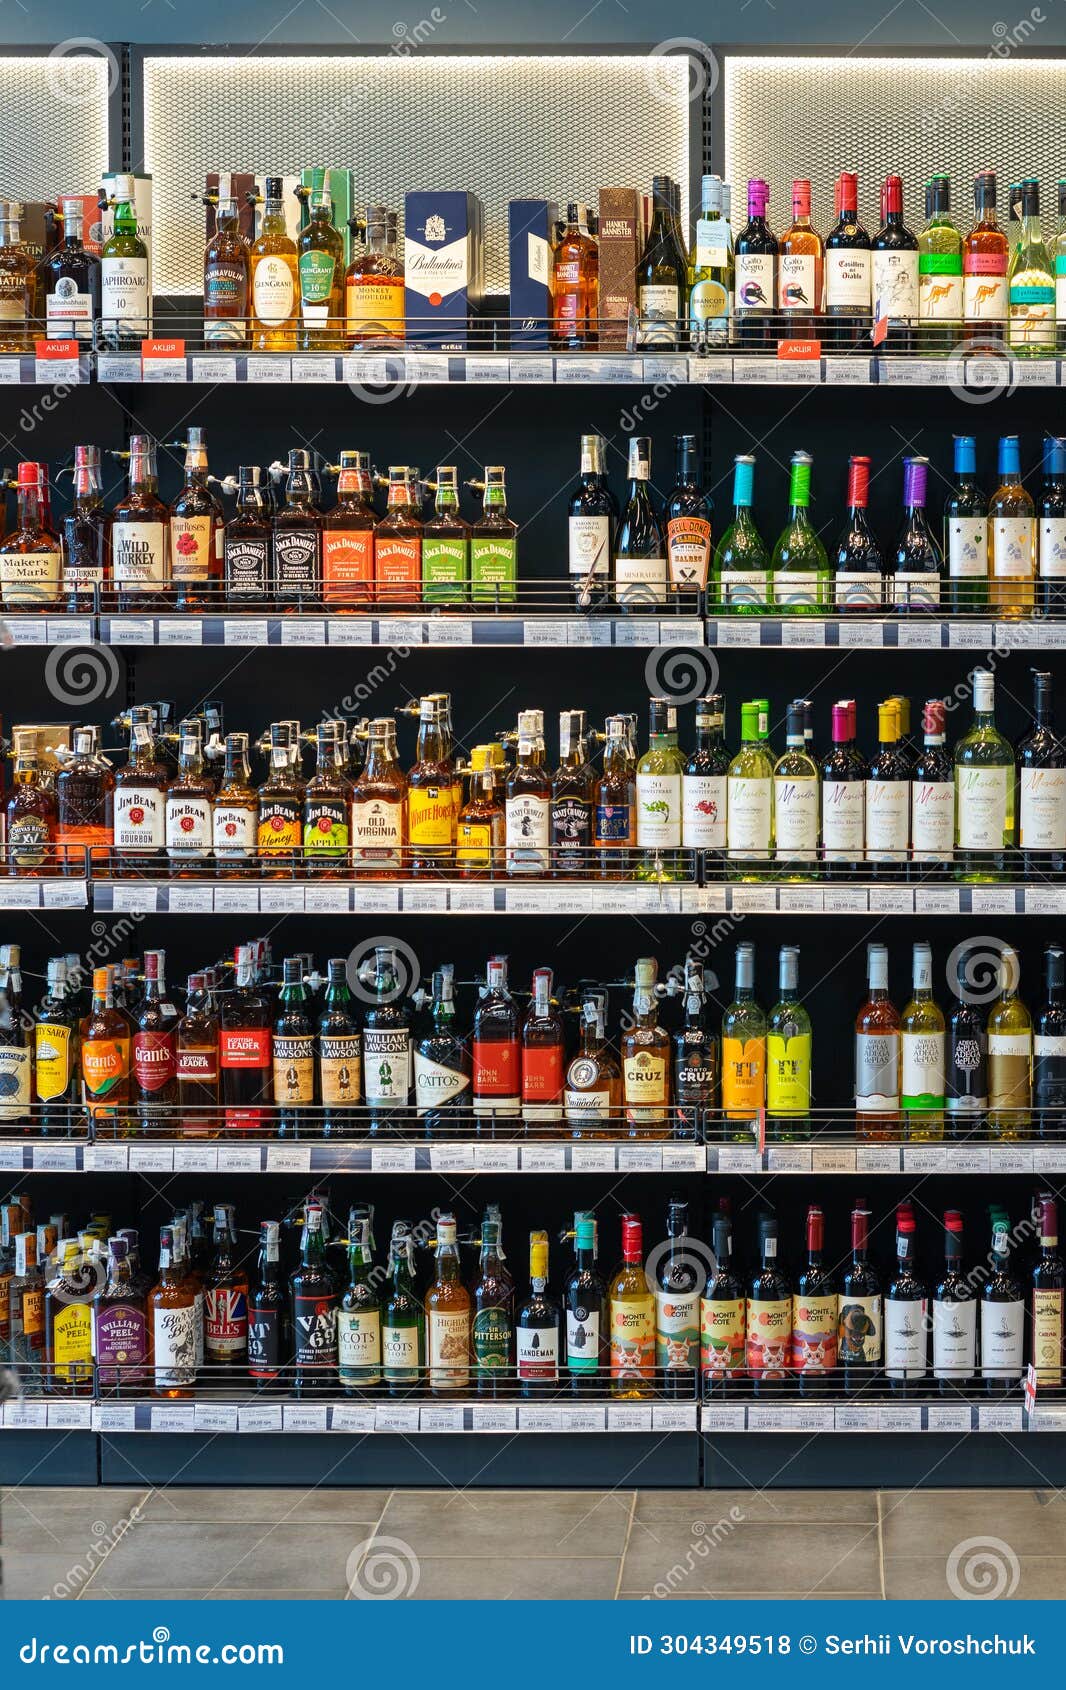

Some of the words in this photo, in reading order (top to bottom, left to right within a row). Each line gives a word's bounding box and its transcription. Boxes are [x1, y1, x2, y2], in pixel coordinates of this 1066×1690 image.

[605, 220, 628, 229] HANKEY
[601, 227, 632, 236] BANNISTER
[408, 252, 464, 272] Ballantine's
[742, 256, 762, 265] Gato
[784, 256, 803, 265] Gato
[740, 264, 764, 274] Negro
[782, 264, 805, 275] Negro
[115, 299, 126, 310] 10
[120, 540, 150, 553] WILD
[275, 539, 291, 553] JACK
[291, 536, 317, 553] DANIEL'S
[326, 541, 342, 553] JACK
[227, 547, 242, 560] JACK
[242, 544, 266, 560] DANIEL'S
[377, 548, 392, 560] JACK
[424, 548, 440, 560] JACK
[474, 548, 489, 560] JACK
[3, 558, 49, 567] Maker's
[116, 552, 155, 566] TURKEY
[16, 568, 49, 577] Mark
[75, 569, 99, 578] TURKEY
[118, 797, 133, 811] JIM
[133, 794, 156, 811] BEAM
[169, 808, 184, 820] JIM
[184, 805, 206, 820] BEAM
[259, 807, 274, 820] JIM
[274, 804, 296, 820] BEAM
[307, 808, 321, 822] JIM
[321, 806, 344, 822] BEAM
[216, 814, 228, 827] JIM
[228, 812, 246, 827] BEAM
[368, 817, 386, 827] OLD
[357, 827, 397, 836] VIRGINIA
[47, 1027, 67, 1039] SARK
[366, 1034, 405, 1044] WILLIAM
[227, 1042, 260, 1050] LEADER
[274, 1040, 313, 1050] WILLIAM
[324, 1040, 360, 1050] WILLIAM
[364, 1042, 408, 1052] LAWSON'S
[135, 1046, 170, 1062] Grant's
[85, 1054, 117, 1068] Grant's
[418, 1073, 460, 1088] CATTO'S
[627, 1071, 662, 1082] CRUZ
[678, 1071, 713, 1082] CRUZ
[670, 1303, 694, 1311] MONTE
[712, 1311, 736, 1319] MONTE
[101, 1319, 141, 1332] WILLIAM
[767, 1318, 784, 1326] COTE
[66, 1330, 88, 1338] PEEL
[207, 1322, 240, 1335] BELL'S
[341, 1332, 375, 1343] SCOTS
[474, 1331, 512, 1341] PITTERSON
[384, 1342, 413, 1351] SCOTS
[521, 1348, 554, 1358] SANDEMAN
